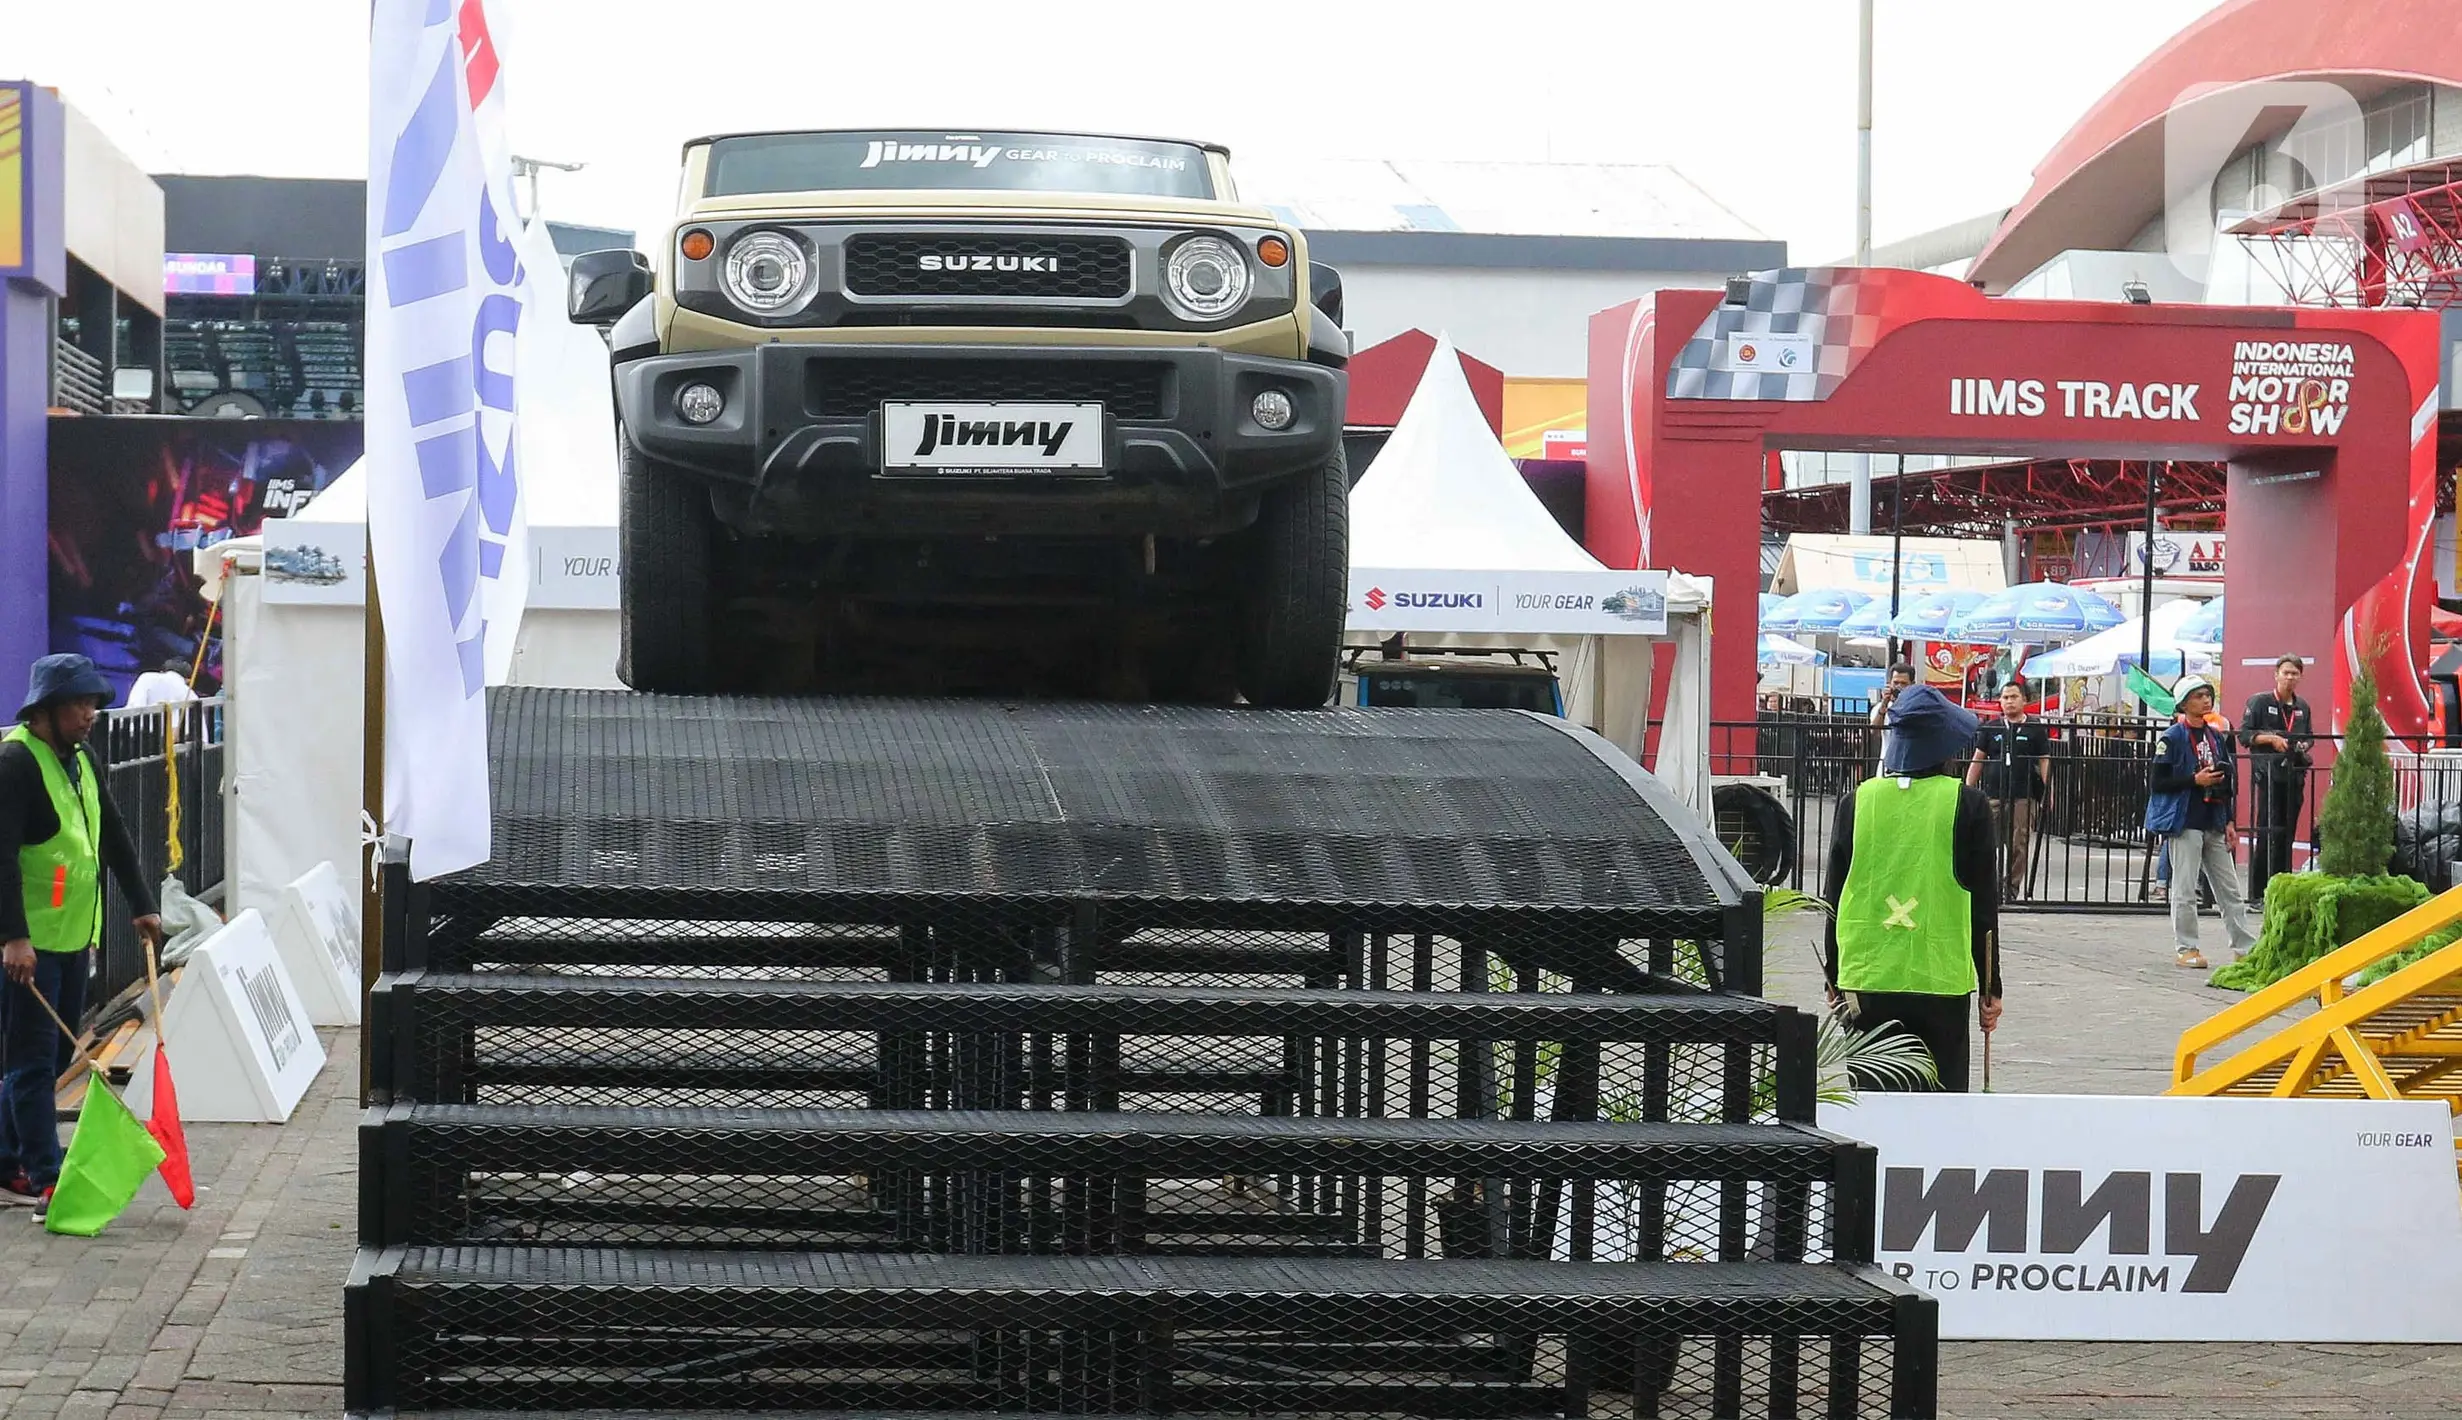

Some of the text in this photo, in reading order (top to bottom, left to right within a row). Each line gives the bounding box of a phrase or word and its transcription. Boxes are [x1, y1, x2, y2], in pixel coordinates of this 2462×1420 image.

[859, 140, 1002, 168] Jimny
[1006, 150, 1057, 161] GEAR
[1086, 152, 1185, 171] PROCLAIM
[2390, 212, 2418, 239] A2
[919, 255, 1058, 272] SUZUKI
[2233, 342, 2355, 363] INDONESIA
[2233, 362, 2355, 378] INTERNATIONAL
[1950, 378, 2201, 421] IIMS TRACK
[2228, 376, 2350, 405] MOTOR
[2227, 402, 2348, 436] SHOW
[914, 414, 1073, 456] Jimny
[267, 479, 295, 490] IIMS
[263, 490, 319, 518] INF
[563, 557, 612, 577] YOUR
[1394, 592, 1594, 610] SUZUKI YOUR GEAR
[2356, 1132, 2433, 1147] YOUR GEAR
[1880, 1166, 2282, 1294] mny
[1926, 1270, 1960, 1290] TO
[1971, 1263, 2169, 1293] PROCLAIM
